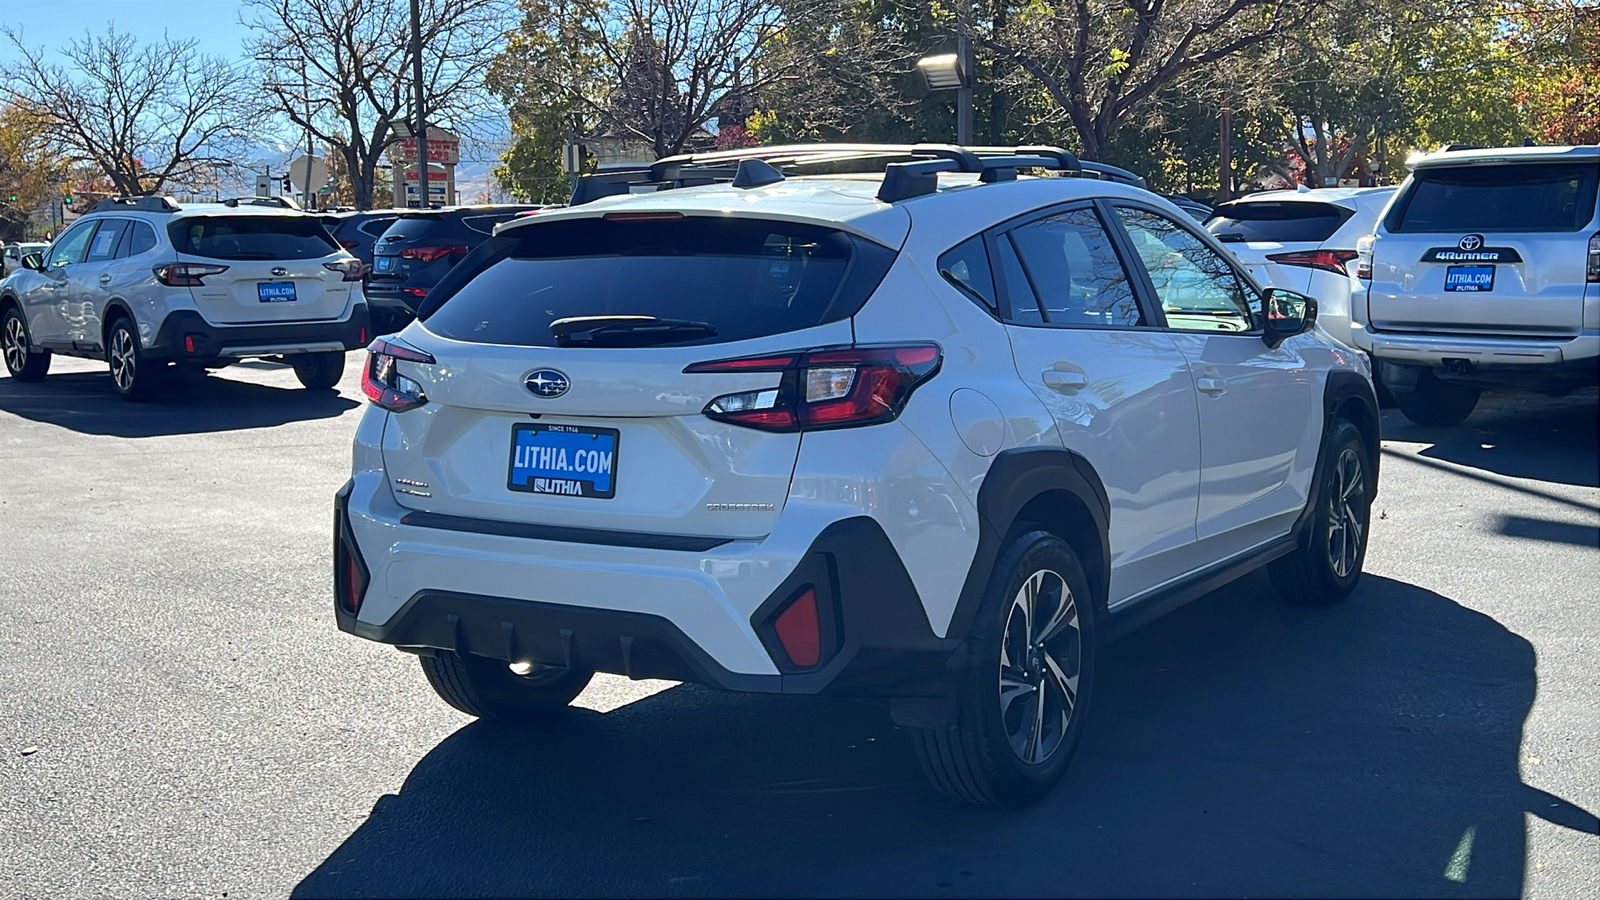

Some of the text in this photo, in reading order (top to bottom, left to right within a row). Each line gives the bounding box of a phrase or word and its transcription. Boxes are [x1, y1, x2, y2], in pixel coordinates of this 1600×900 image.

[1435, 252, 1499, 260] 4RUNNER
[1447, 273, 1492, 284] LITHIA.COM
[260, 287, 295, 297] LITHIA.COM
[514, 445, 612, 475] LITHIA.COM
[544, 478, 583, 495] LITHIA
[706, 503, 775, 511] CROSSTREK
